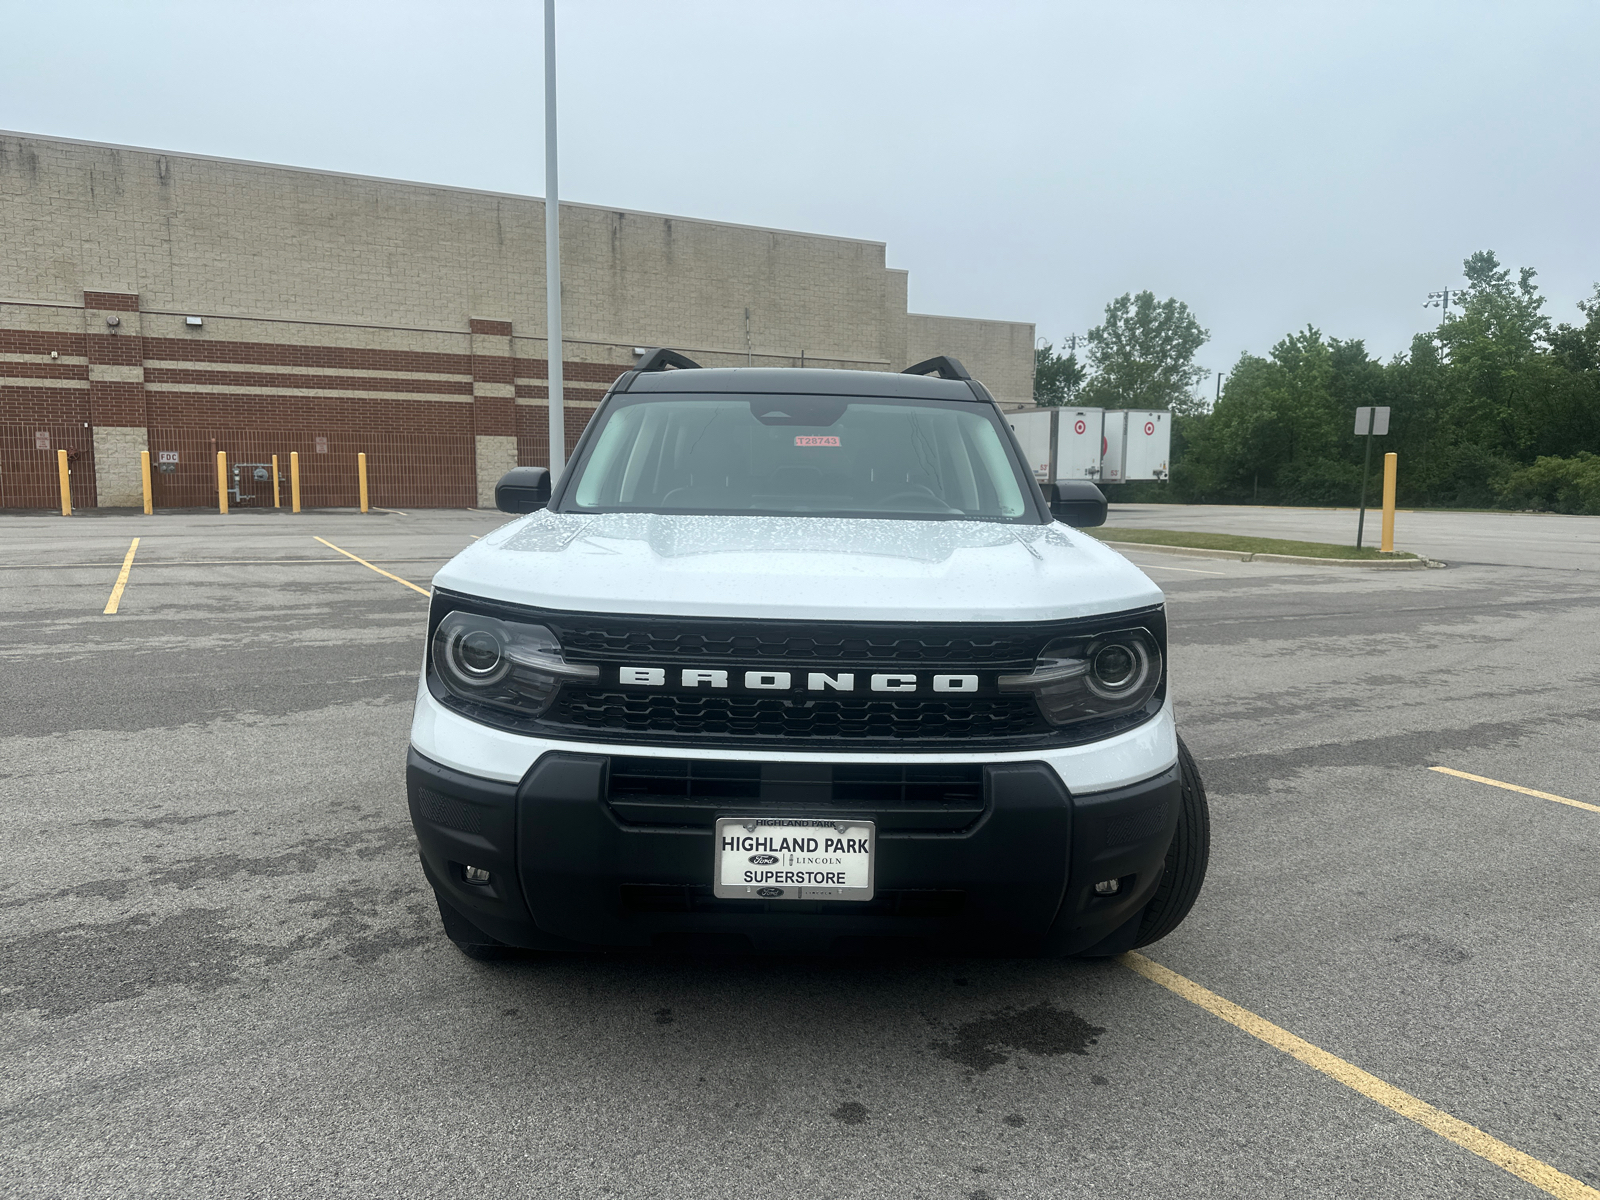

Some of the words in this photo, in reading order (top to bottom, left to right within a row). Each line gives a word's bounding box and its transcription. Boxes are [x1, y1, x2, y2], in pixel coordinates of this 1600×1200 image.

[160, 453, 177, 461] FDC
[619, 666, 979, 693] BRONCO
[755, 819, 809, 828] HIGHLAND
[811, 820, 836, 828] PARK
[722, 836, 819, 853] HIGHLAND
[824, 838, 869, 854] PARK
[796, 857, 842, 865] LINCOLN
[743, 870, 846, 884] SUPERSTORE
